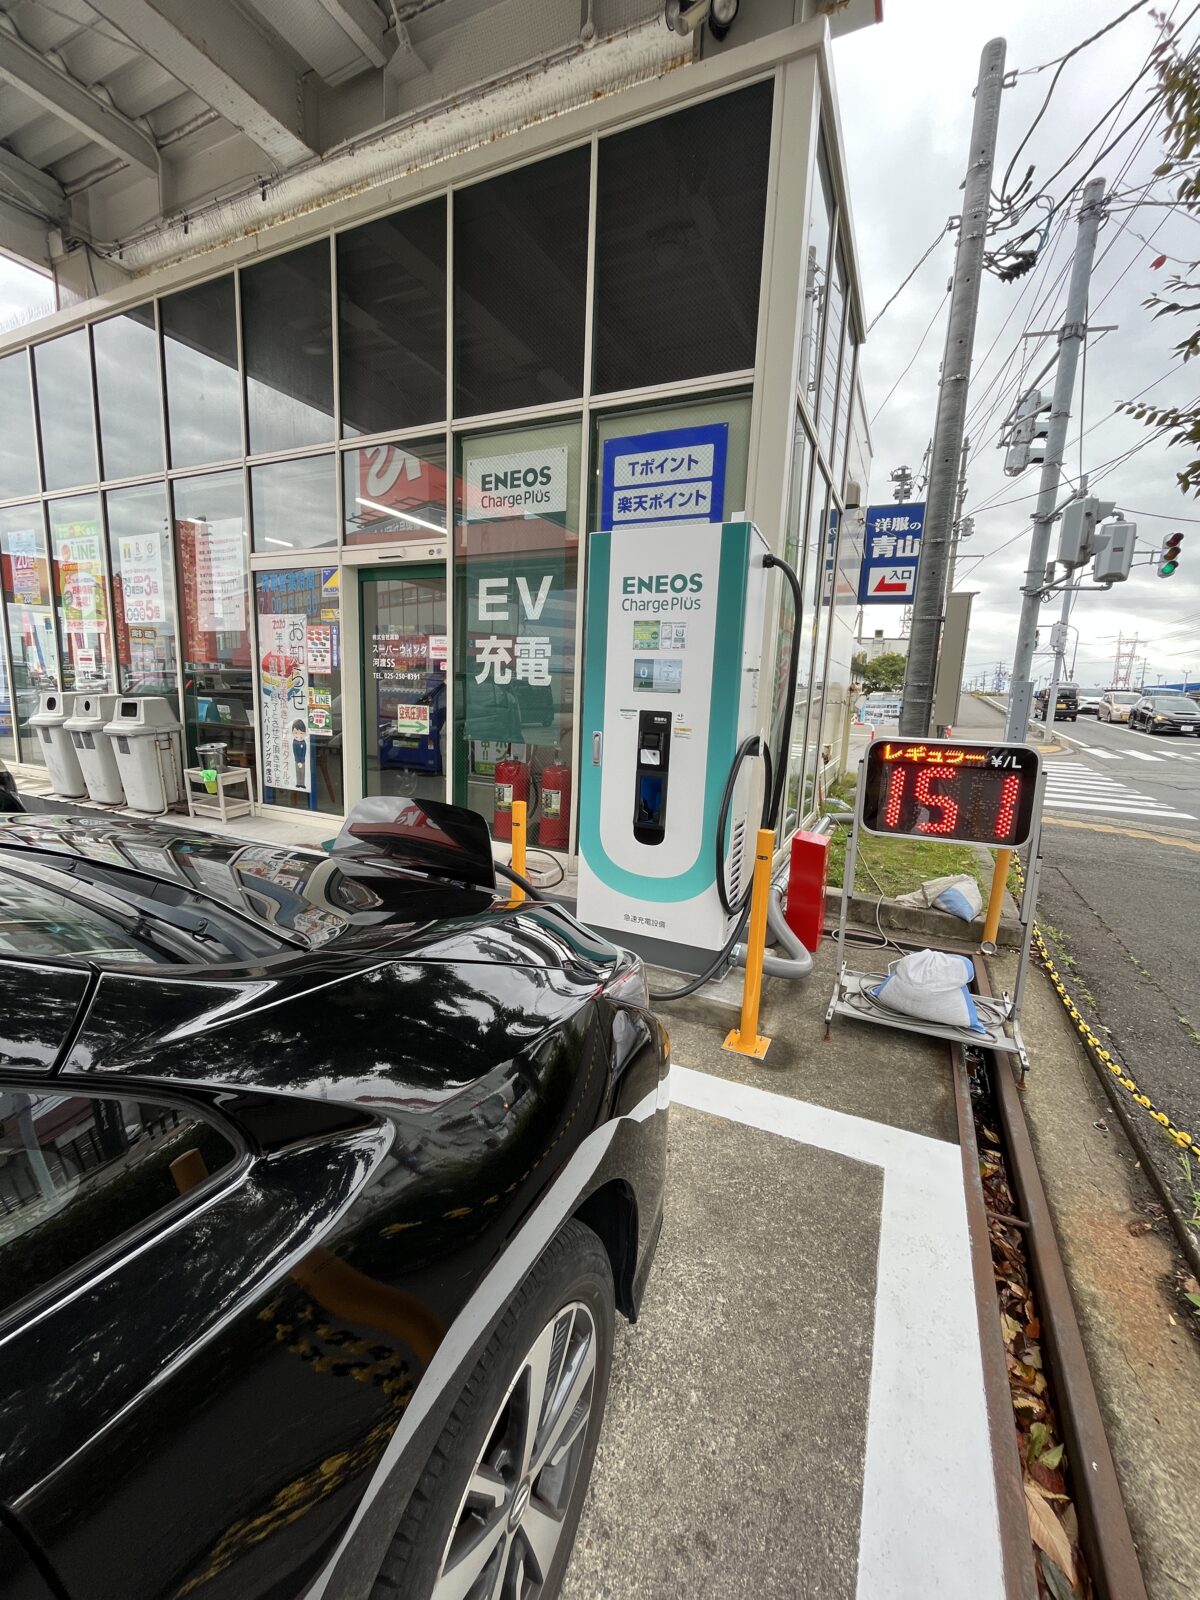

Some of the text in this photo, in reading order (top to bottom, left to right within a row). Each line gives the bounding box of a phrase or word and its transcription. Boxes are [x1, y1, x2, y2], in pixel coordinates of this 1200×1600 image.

[628, 453, 699, 477] Tポイント
[481, 465, 552, 492] ENEOS
[481, 493, 523, 509] Charge
[617, 489, 707, 514] 楽天ポイント
[875, 516, 922, 533] 洋服の
[871, 535, 921, 559] 青山
[622, 573, 703, 594] ENEOS
[889, 569, 912, 581] 入口
[478, 575, 554, 621] EV
[621, 598, 669, 613] Charge
[289, 620, 306, 711] お知らせ
[475, 635, 552, 687] 充電
[314, 695, 330, 705] LINE
[884, 744, 986, 764] レギュラー
[623, 913, 666, 929] 急速充電設備
